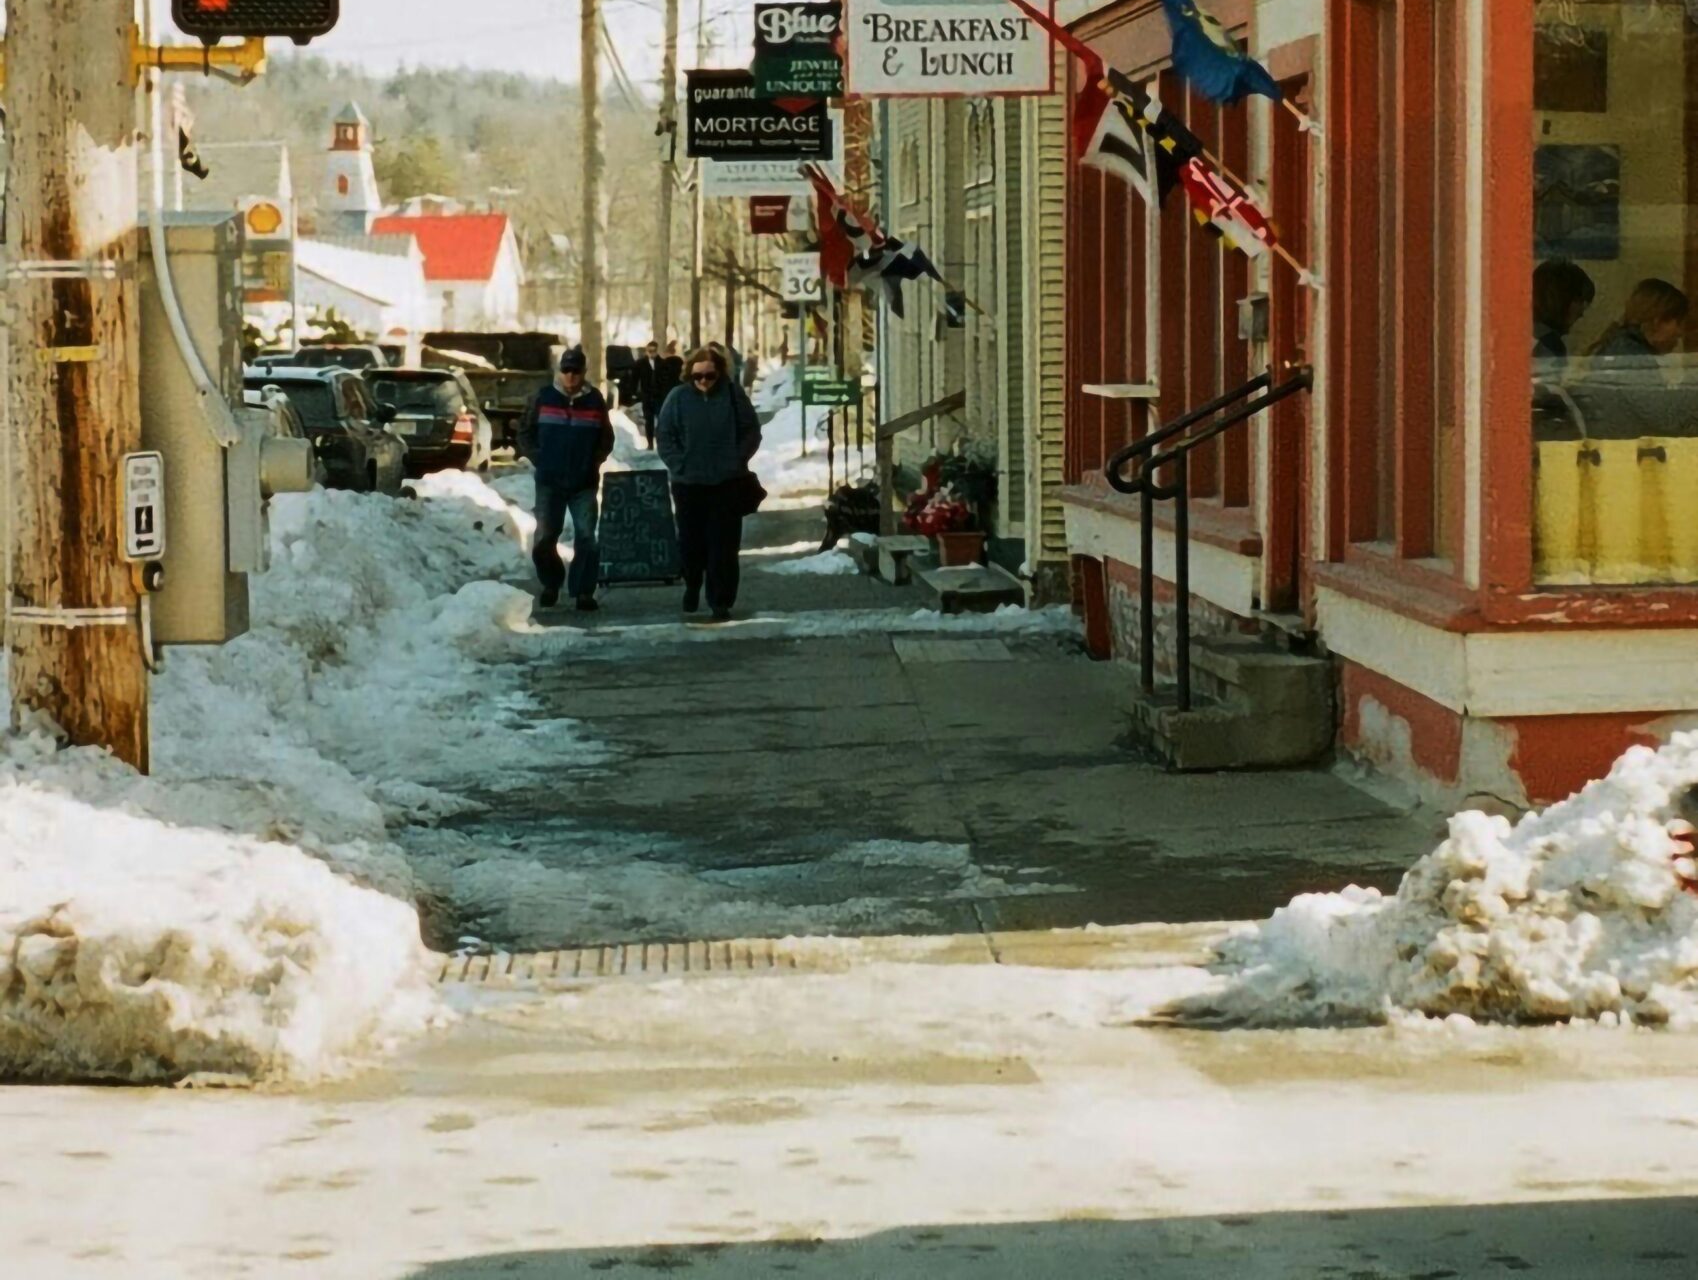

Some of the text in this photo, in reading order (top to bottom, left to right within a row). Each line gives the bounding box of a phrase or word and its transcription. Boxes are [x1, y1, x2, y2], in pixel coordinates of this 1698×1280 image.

[758, 6, 838, 43] Blue
[862, 12, 1033, 43] BREAKFAST
[882, 46, 1014, 76] & LUNCH
[766, 80, 832, 93] UNIQUE
[694, 115, 820, 134] MORTGAGE
